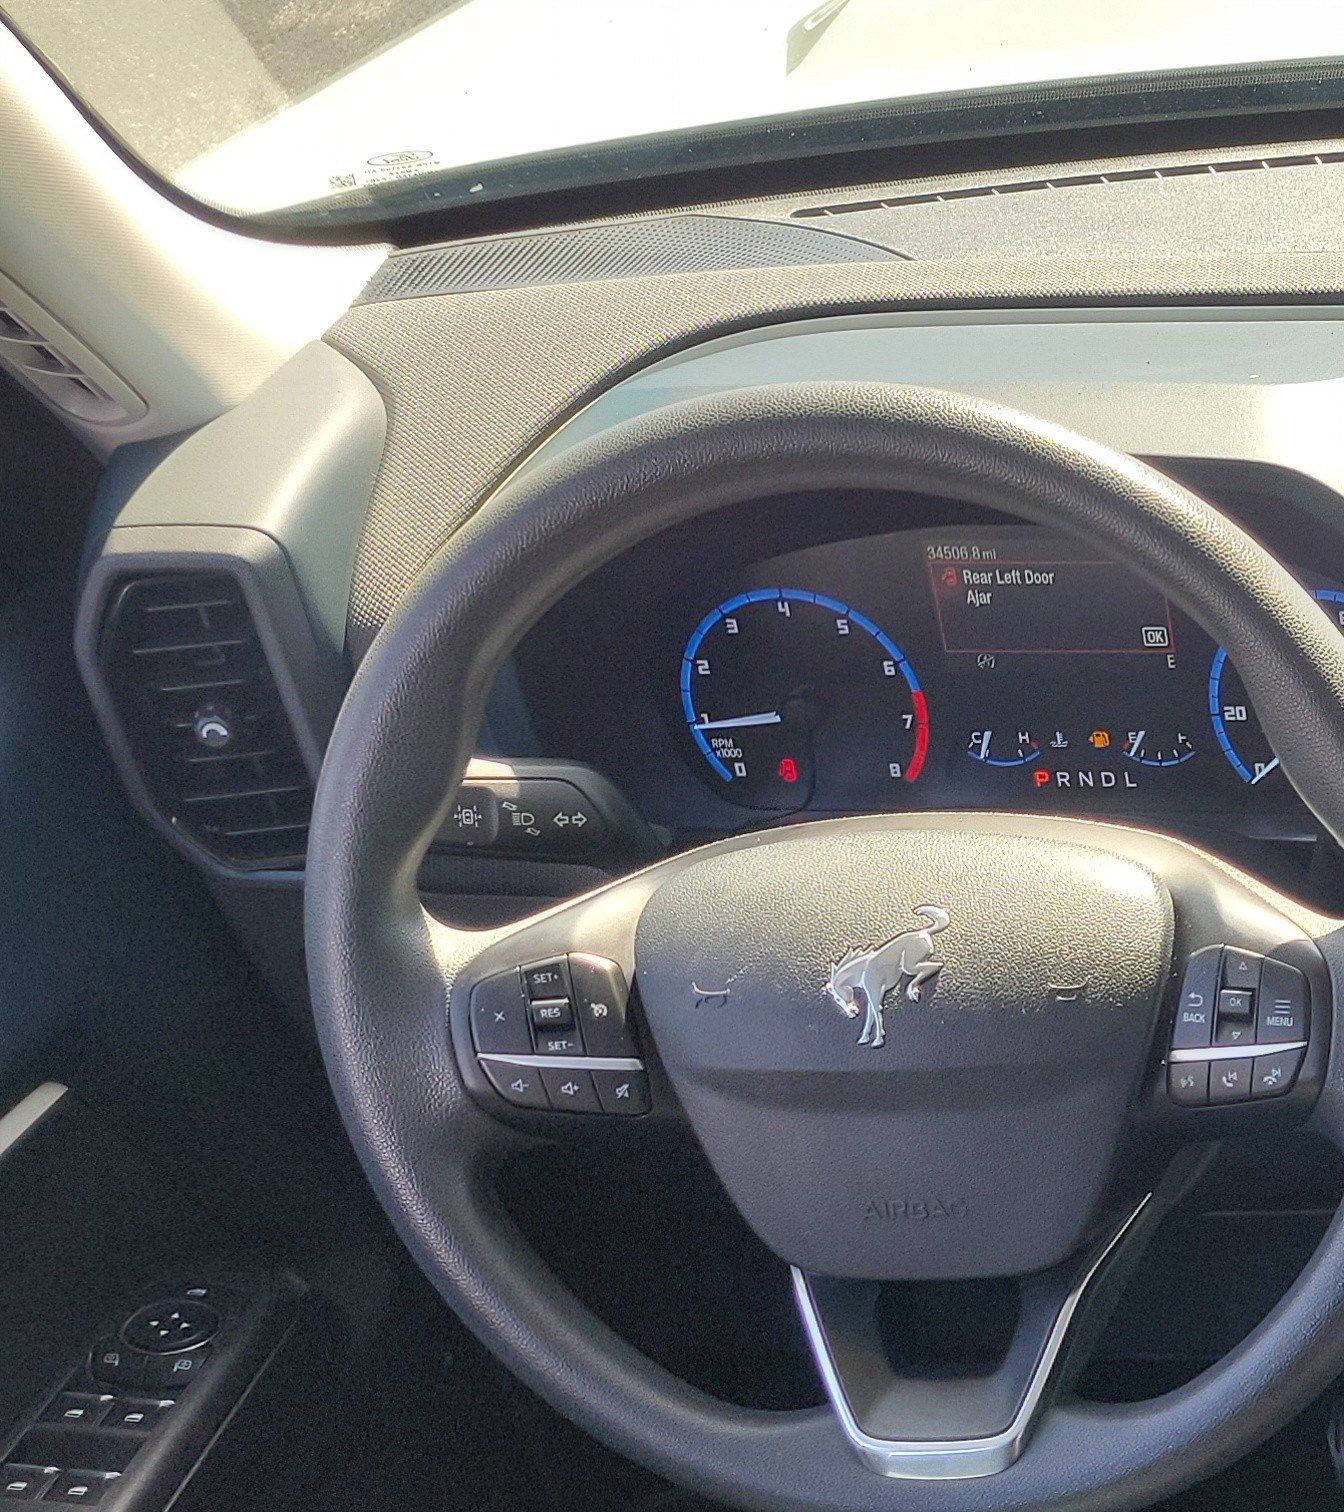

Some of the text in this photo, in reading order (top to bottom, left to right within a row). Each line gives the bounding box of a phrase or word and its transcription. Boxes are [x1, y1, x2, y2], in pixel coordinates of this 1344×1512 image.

[927, 546, 980, 560] 34506.8
[963, 568, 1055, 587] Rear Left Door
[967, 590, 992, 607] Ajar
[777, 601, 791, 617] 4
[725, 618, 739, 634] 3
[837, 619, 849, 635] 5
[1146, 630, 1165, 644] OK
[697, 660, 710, 675] 2
[883, 660, 896, 676] 6
[1167, 654, 1176, 669] E
[1223, 706, 1247, 721] 20
[902, 714, 913, 729] 7
[711, 738, 733, 749] RPM
[971, 732, 982, 743] C
[1018, 732, 1029, 743] H
[716, 748, 742, 759] x1000
[734, 762, 747, 777] 0
[889, 763, 901, 778] 8
[1034, 771, 1137, 788] P R N D L
[1229, 997, 1242, 1007] OK
[540, 1008, 560, 1018] RES
[1183, 1012, 1206, 1024] BACK
[1267, 1016, 1294, 1027] MENU
